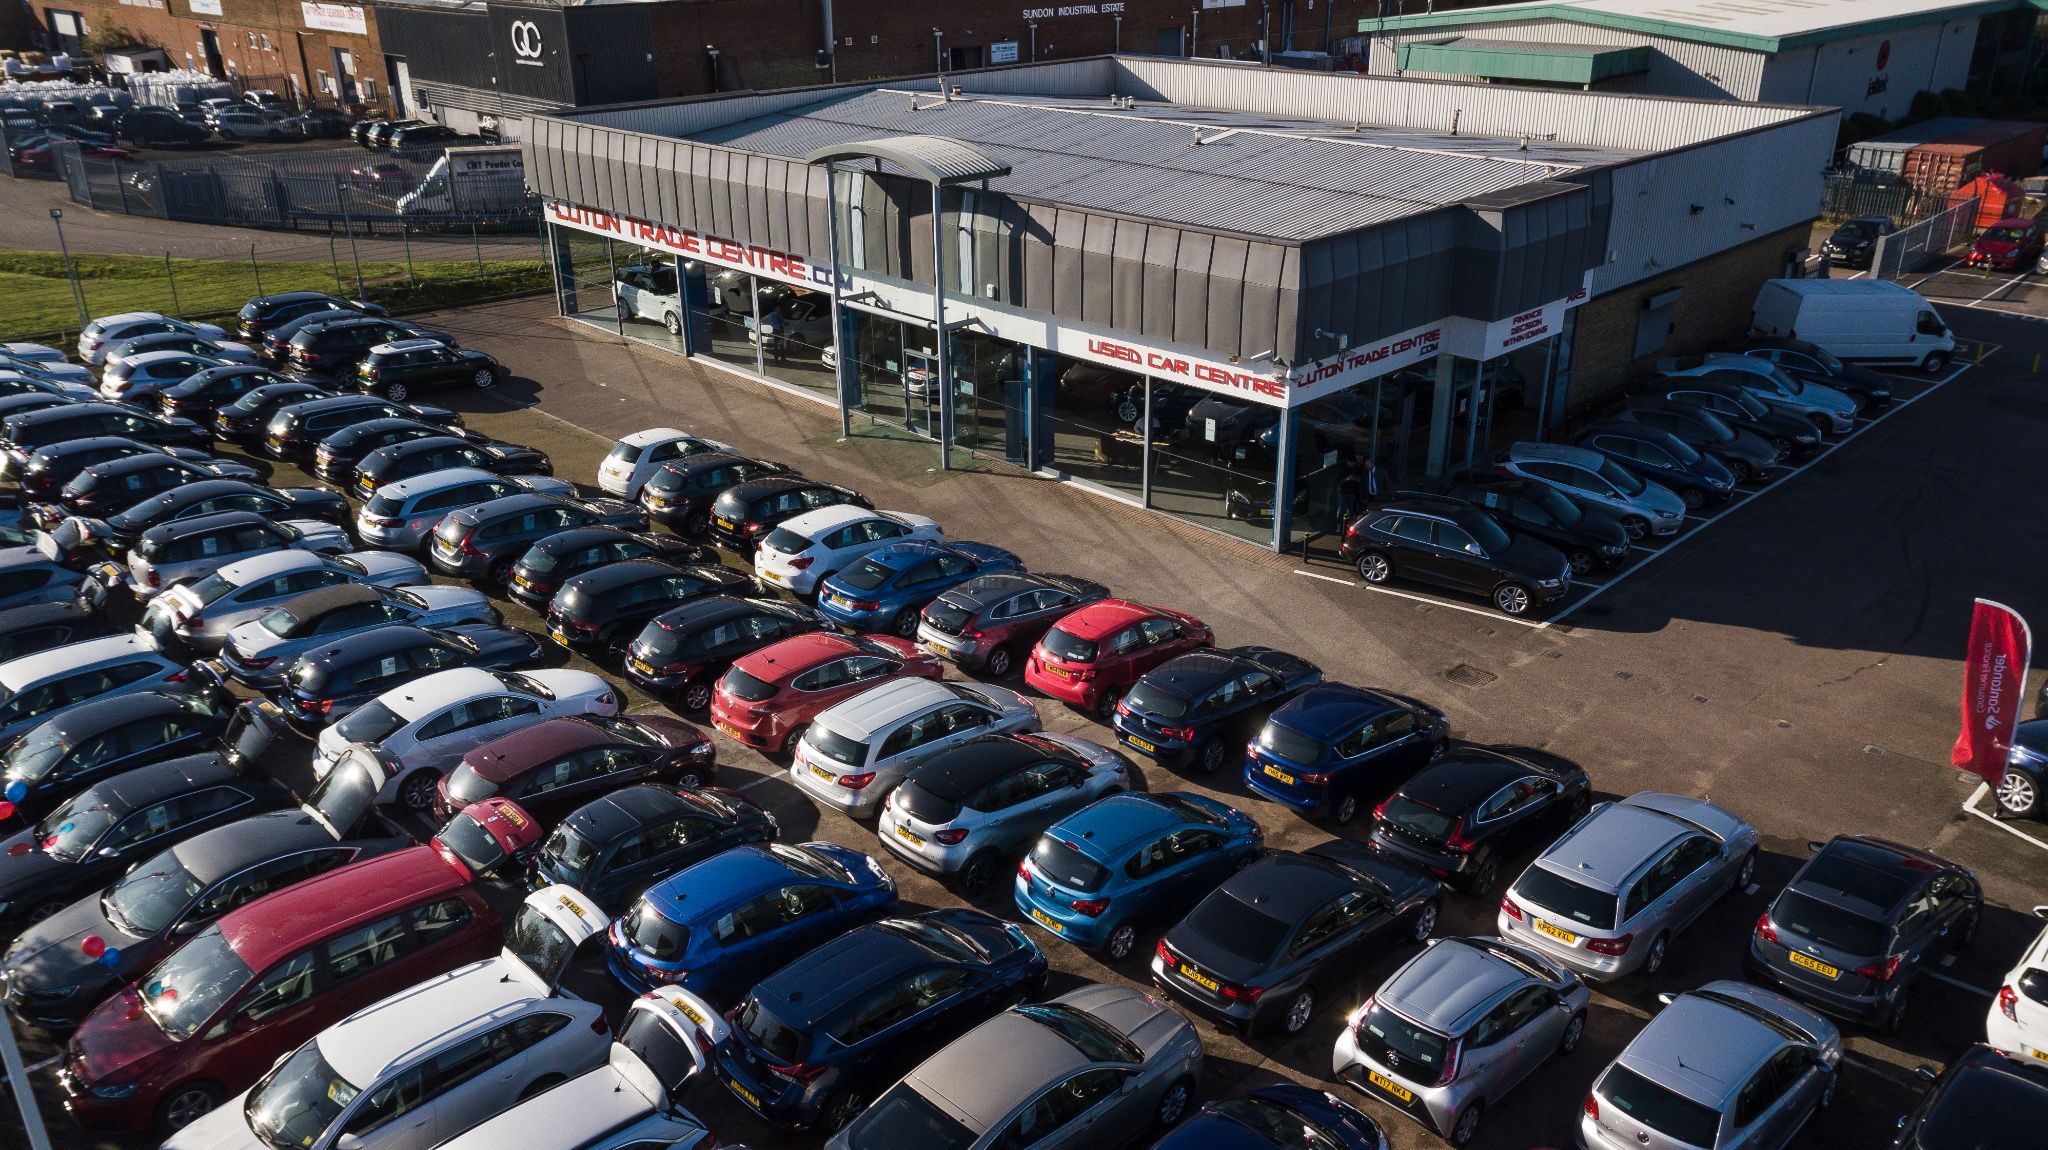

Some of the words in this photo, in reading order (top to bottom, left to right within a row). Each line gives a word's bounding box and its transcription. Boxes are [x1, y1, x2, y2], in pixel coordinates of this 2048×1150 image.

[1022, 8, 1054, 19] SUNDON
[1058, 4, 1098, 16] INDUSTRIAL
[1101, 2, 1125, 13] ESTATE
[485, 160, 510, 169] Powder
[554, 200, 621, 234] LUTON
[625, 213, 700, 253] TRADE
[1298, 361, 1344, 388] LUTON
[1347, 346, 1390, 370] TRADE
[1392, 328, 1441, 356] CENTRE
[1089, 338, 1142, 365] USED
[1147, 352, 1190, 376] CAR
[1194, 363, 1286, 400] CENTRE
[1537, 922, 1556, 935] KP62
[1556, 929, 1570, 941] VXL
[1793, 954, 1815, 968] GC65
[1816, 963, 1833, 975] EEU
